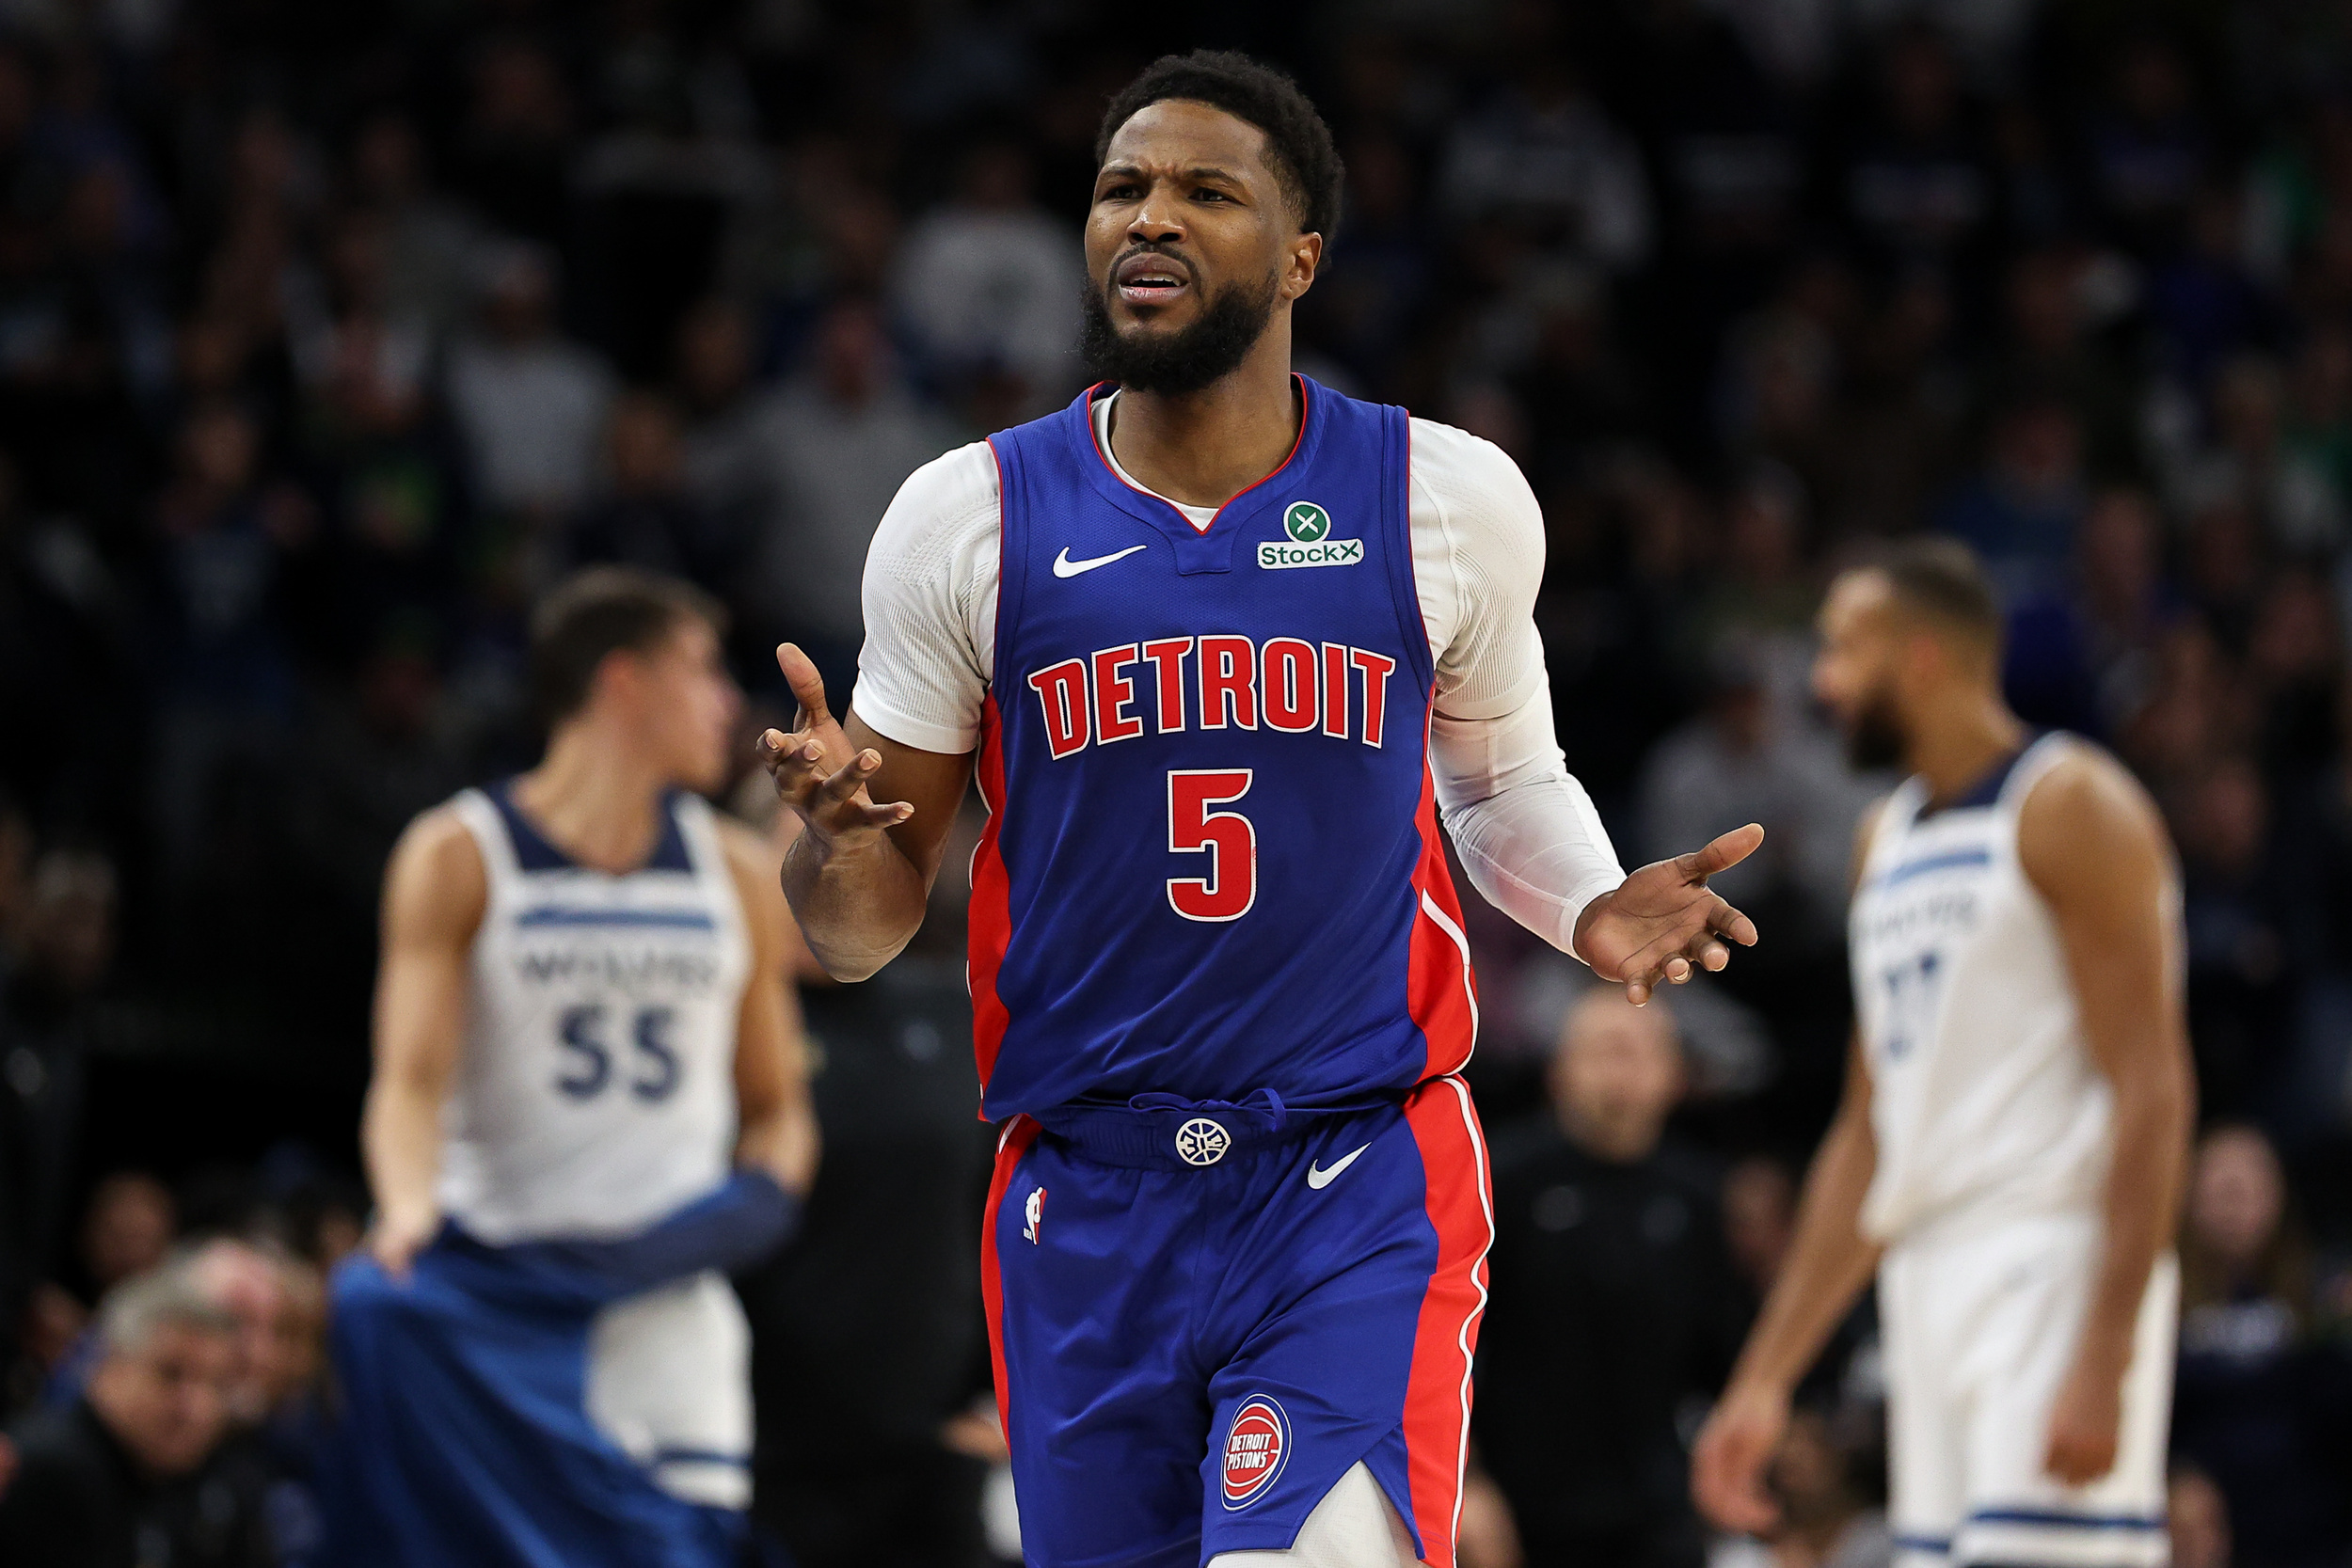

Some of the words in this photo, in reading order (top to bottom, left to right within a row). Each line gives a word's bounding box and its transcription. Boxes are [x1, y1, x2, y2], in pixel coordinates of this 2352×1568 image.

[1262, 541, 1359, 565] StockX
[1027, 635, 1396, 761] DETROIT
[1167, 768, 1257, 922] 5
[555, 1003, 684, 1105] 55
[1227, 1451, 1268, 1471] PISTONS
[1231, 1433, 1272, 1452] DETROIT
